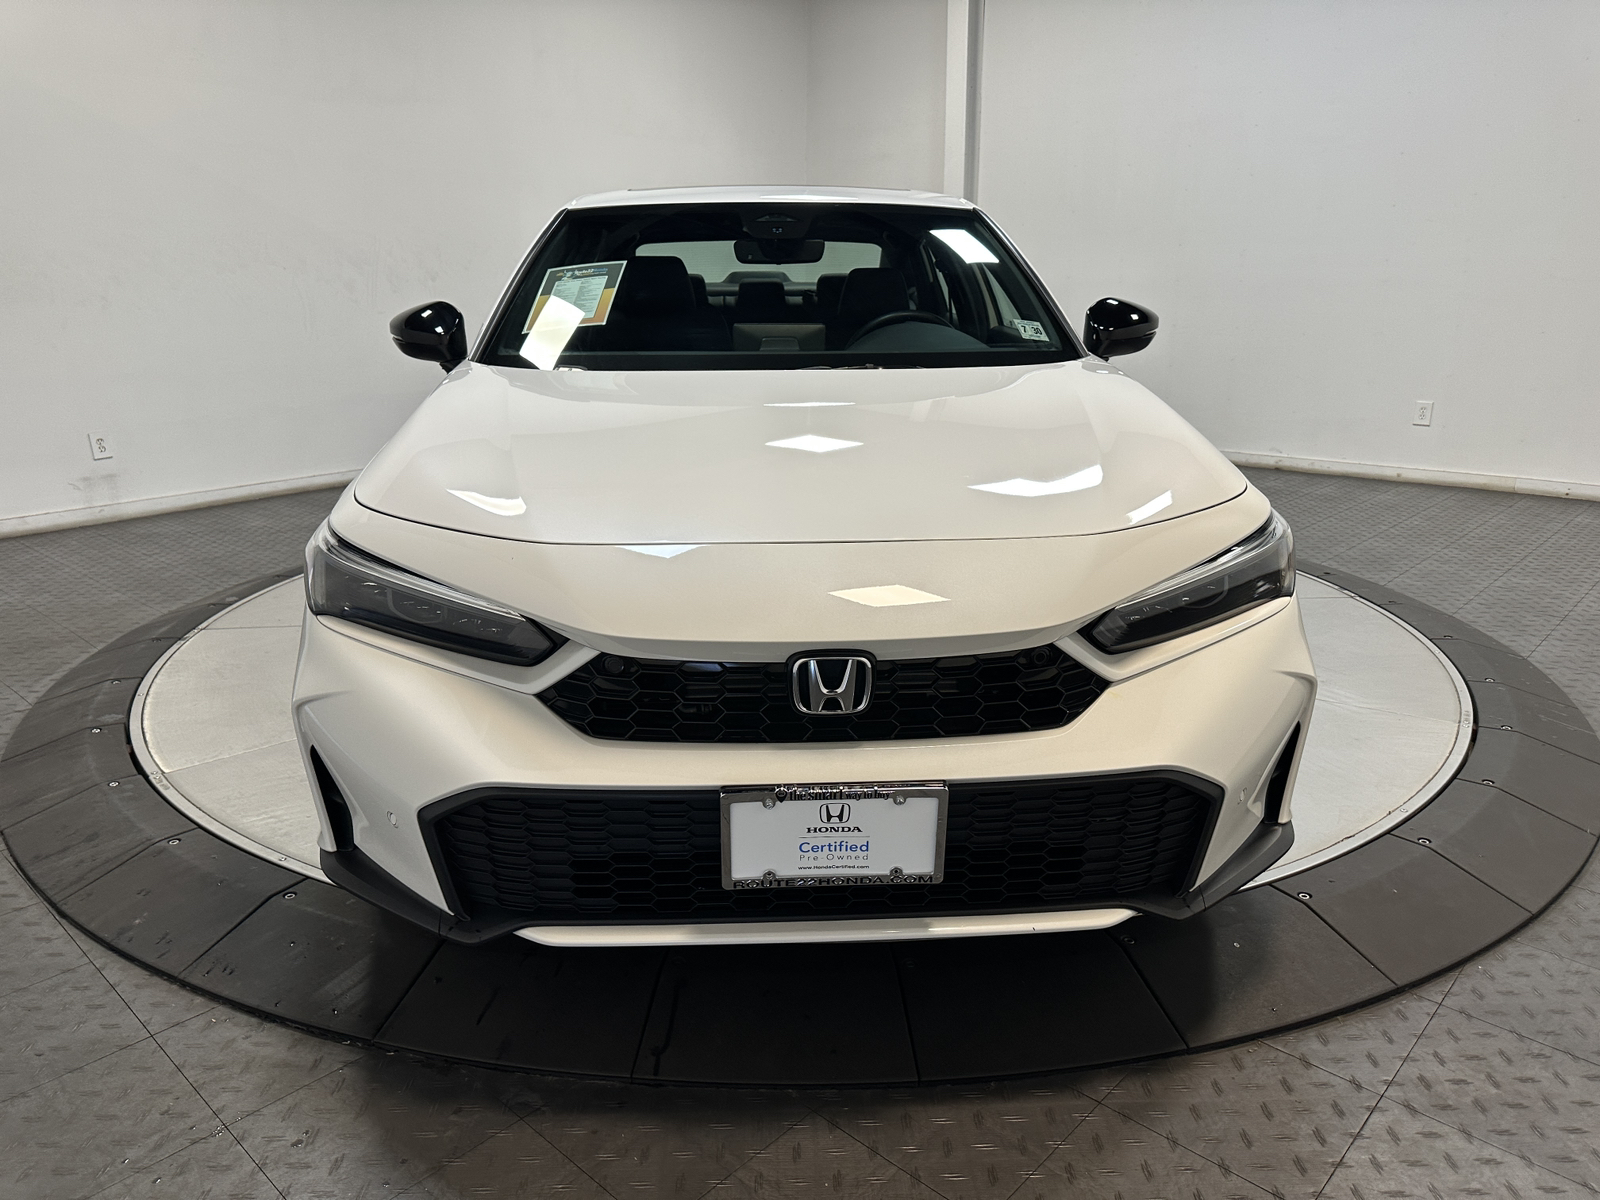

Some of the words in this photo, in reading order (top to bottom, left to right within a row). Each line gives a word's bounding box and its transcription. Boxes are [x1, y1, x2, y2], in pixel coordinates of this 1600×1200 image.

[846, 791, 861, 801] way
[863, 788, 873, 799] to
[806, 826, 863, 834] HONDA
[799, 840, 869, 853] Certified
[799, 853, 868, 861] Pre-Owned
[733, 875, 933, 889] ROUTE22HONDA.COM
